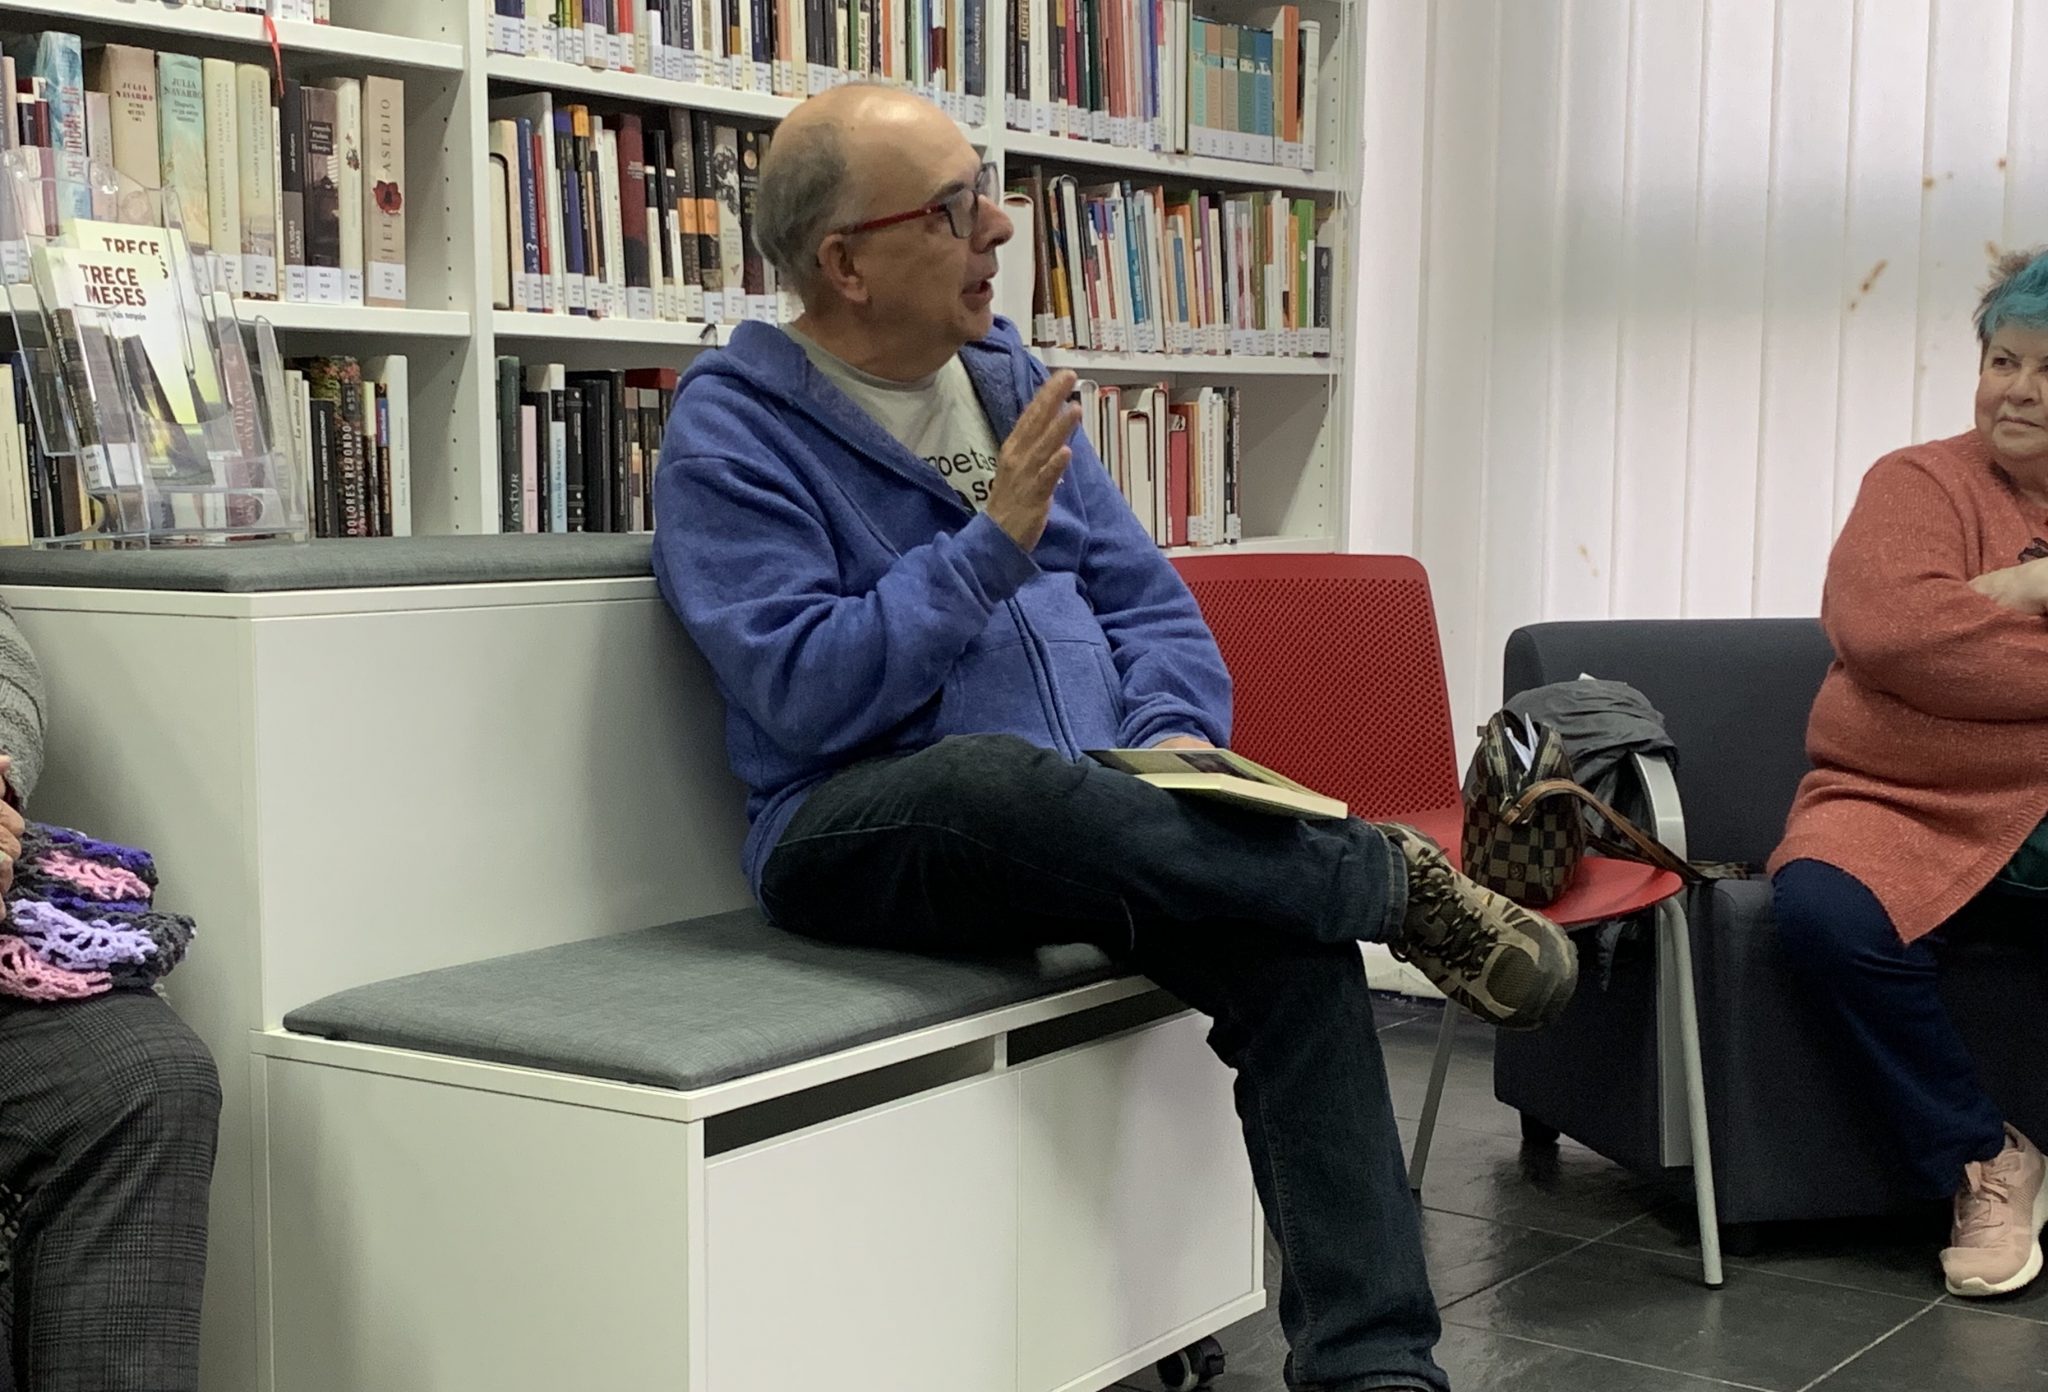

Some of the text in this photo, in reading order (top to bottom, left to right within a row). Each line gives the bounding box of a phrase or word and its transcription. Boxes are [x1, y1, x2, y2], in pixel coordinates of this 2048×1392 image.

[1020, 0, 1029, 41] LUCIFE
[122, 82, 147, 92] JULIA
[164, 86, 202, 97] NAVARRO
[172, 78, 196, 89] JULIA
[115, 90, 153, 101] NAVARRO
[380, 98, 392, 241] EL ASEDIO
[682, 163, 691, 193] ISABEL
[704, 161, 712, 188] ISABEL
[527, 178, 536, 240] PREGUNTAS
[102, 237, 159, 255] TRECE
[526, 242, 538, 252] 3
[78, 264, 139, 286] TRECE
[84, 285, 147, 306] MESES
[342, 424, 358, 535] DOLORES REDONDO
[972, 479, 994, 501] s
[509, 473, 520, 522] ASTUR
